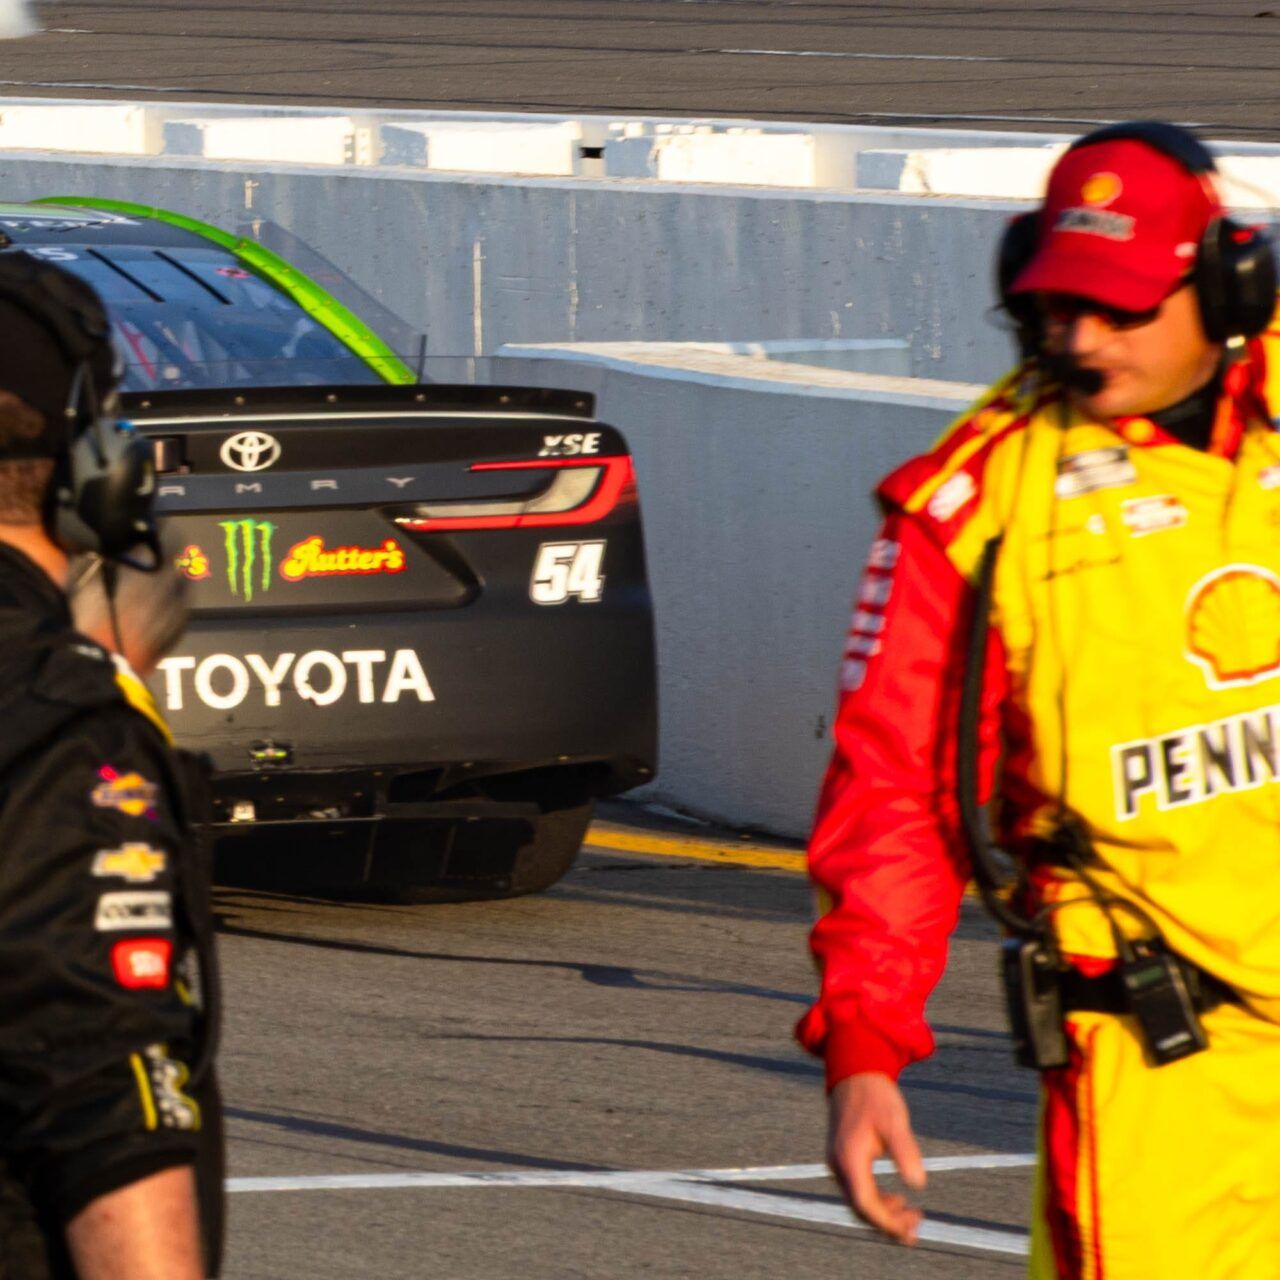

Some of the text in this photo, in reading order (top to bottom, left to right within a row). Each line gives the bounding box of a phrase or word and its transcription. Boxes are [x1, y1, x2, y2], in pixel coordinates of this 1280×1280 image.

[538, 433, 602, 456] XSE
[159, 476, 415, 498] AMRY
[285, 536, 405, 578] Rutter's
[532, 540, 608, 604] 54
[156, 649, 437, 710] TOYOTA
